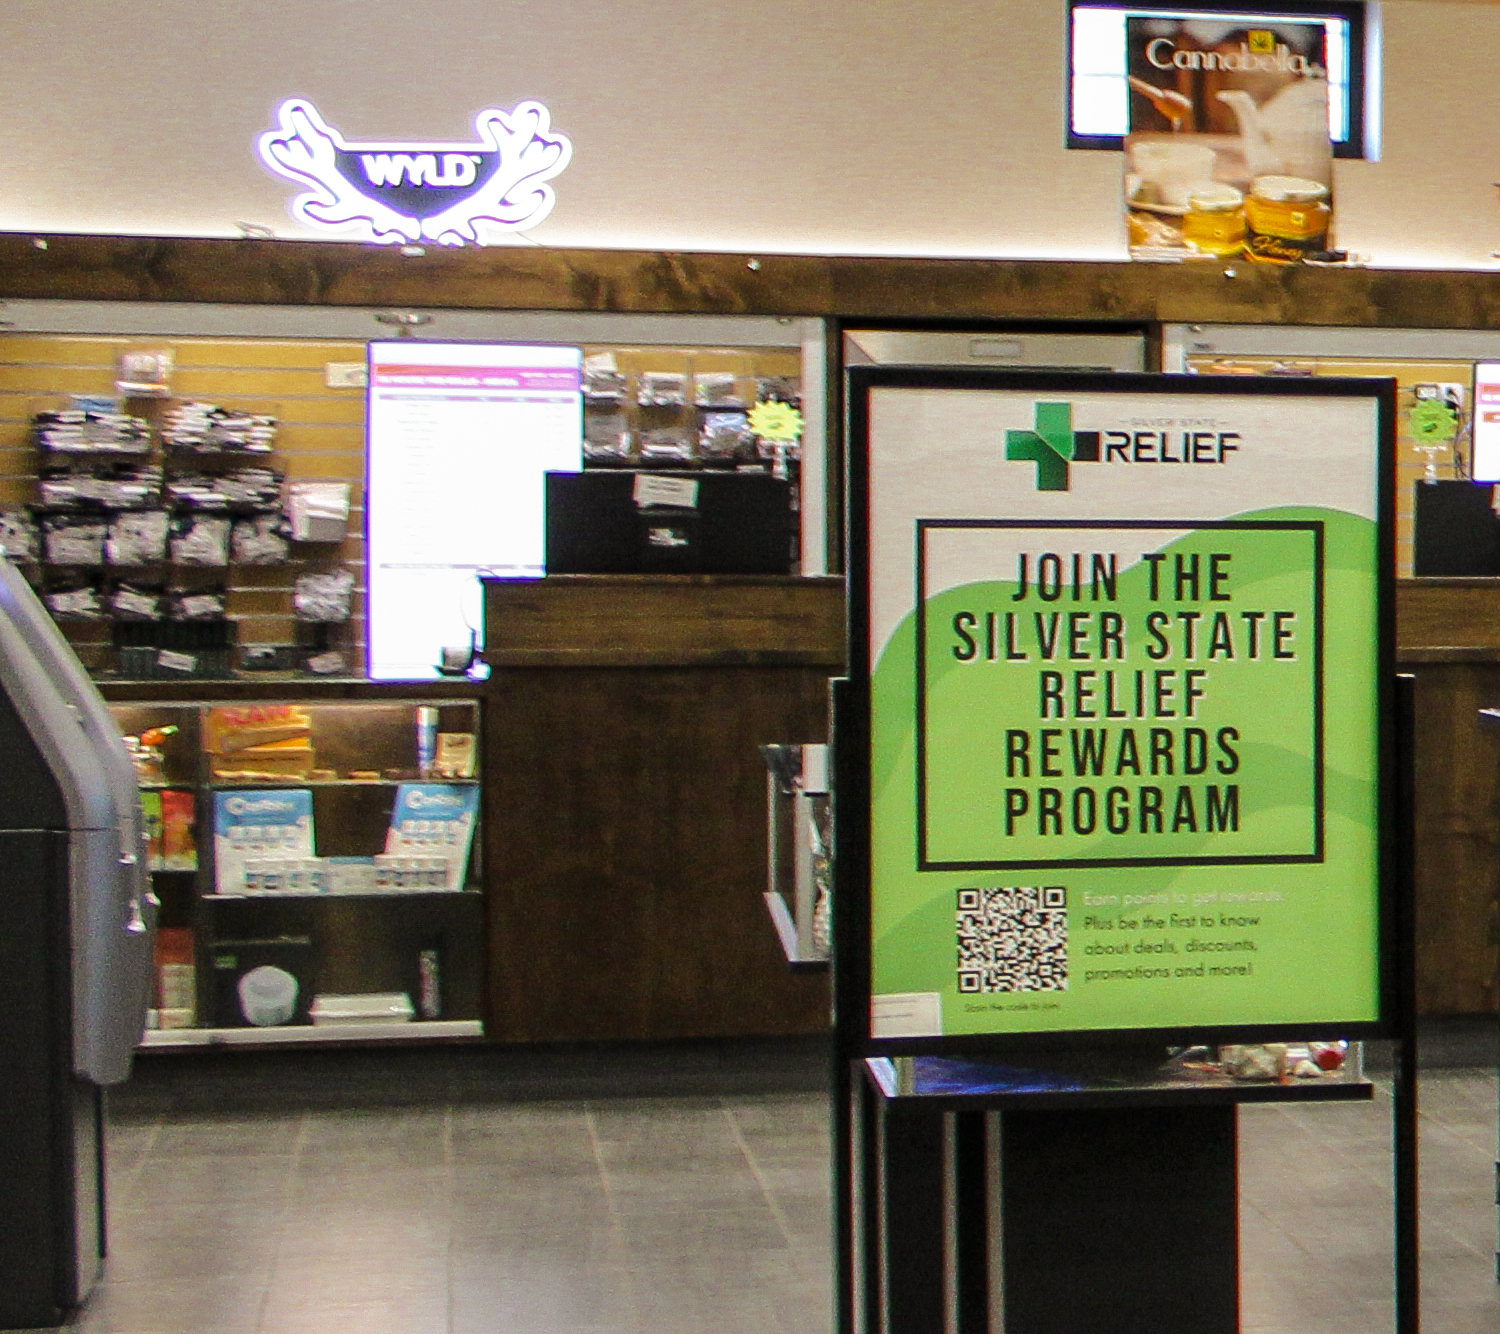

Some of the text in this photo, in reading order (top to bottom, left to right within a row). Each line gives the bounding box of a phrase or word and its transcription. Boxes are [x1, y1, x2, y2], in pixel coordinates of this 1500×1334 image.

[360, 153, 479, 187] WYLD
[1104, 431, 1243, 464] RELIEF
[1012, 552, 1233, 603] JOIN THE
[951, 610, 1298, 663] SILVER STATE
[1039, 669, 1208, 720] RELIEF
[1005, 726, 1241, 780] REWARDS
[1004, 785, 1241, 837] PROGRAM
[1084, 892, 1119, 907] Earn
[1122, 893, 1170, 907] points
[1174, 892, 1188, 905] to
[1193, 892, 1218, 907] get
[1083, 913, 1261, 930] Plus be the first to know
[1084, 940, 1130, 955] about
[1084, 962, 1254, 984] promotions and more!
